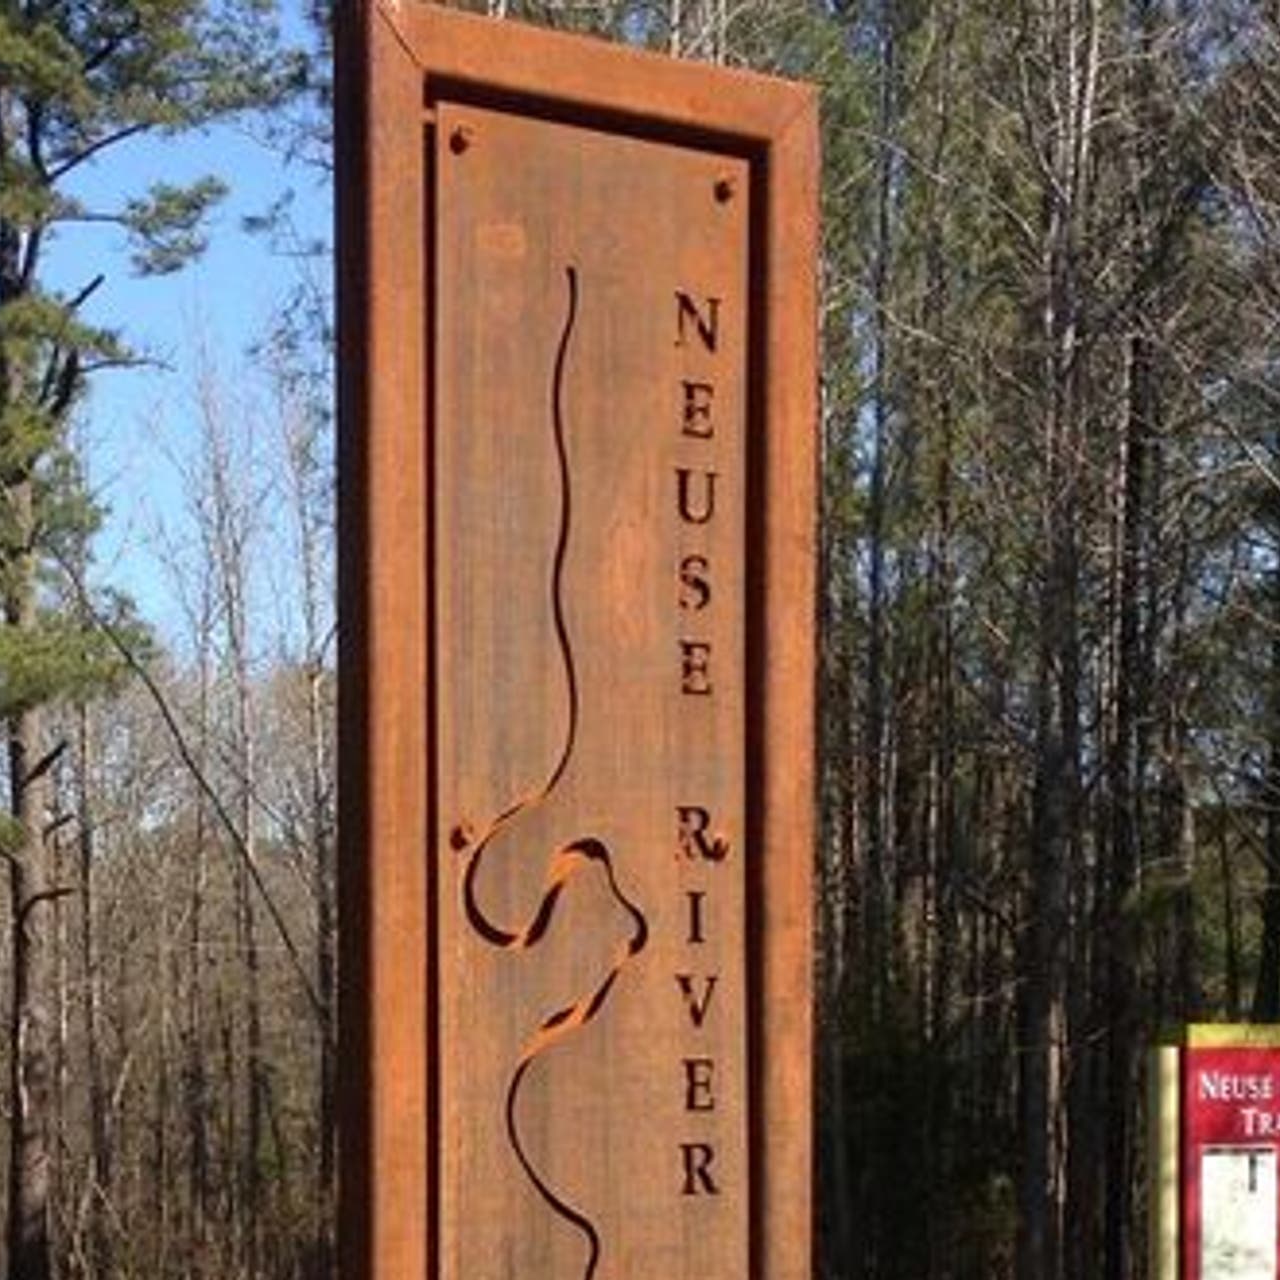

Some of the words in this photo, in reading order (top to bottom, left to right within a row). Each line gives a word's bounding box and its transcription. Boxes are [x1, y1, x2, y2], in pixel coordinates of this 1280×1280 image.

[674, 290, 721, 698] NEUSE
[674, 806, 724, 1196] RIVER
[1199, 1069, 1272, 1099] NEUSE
